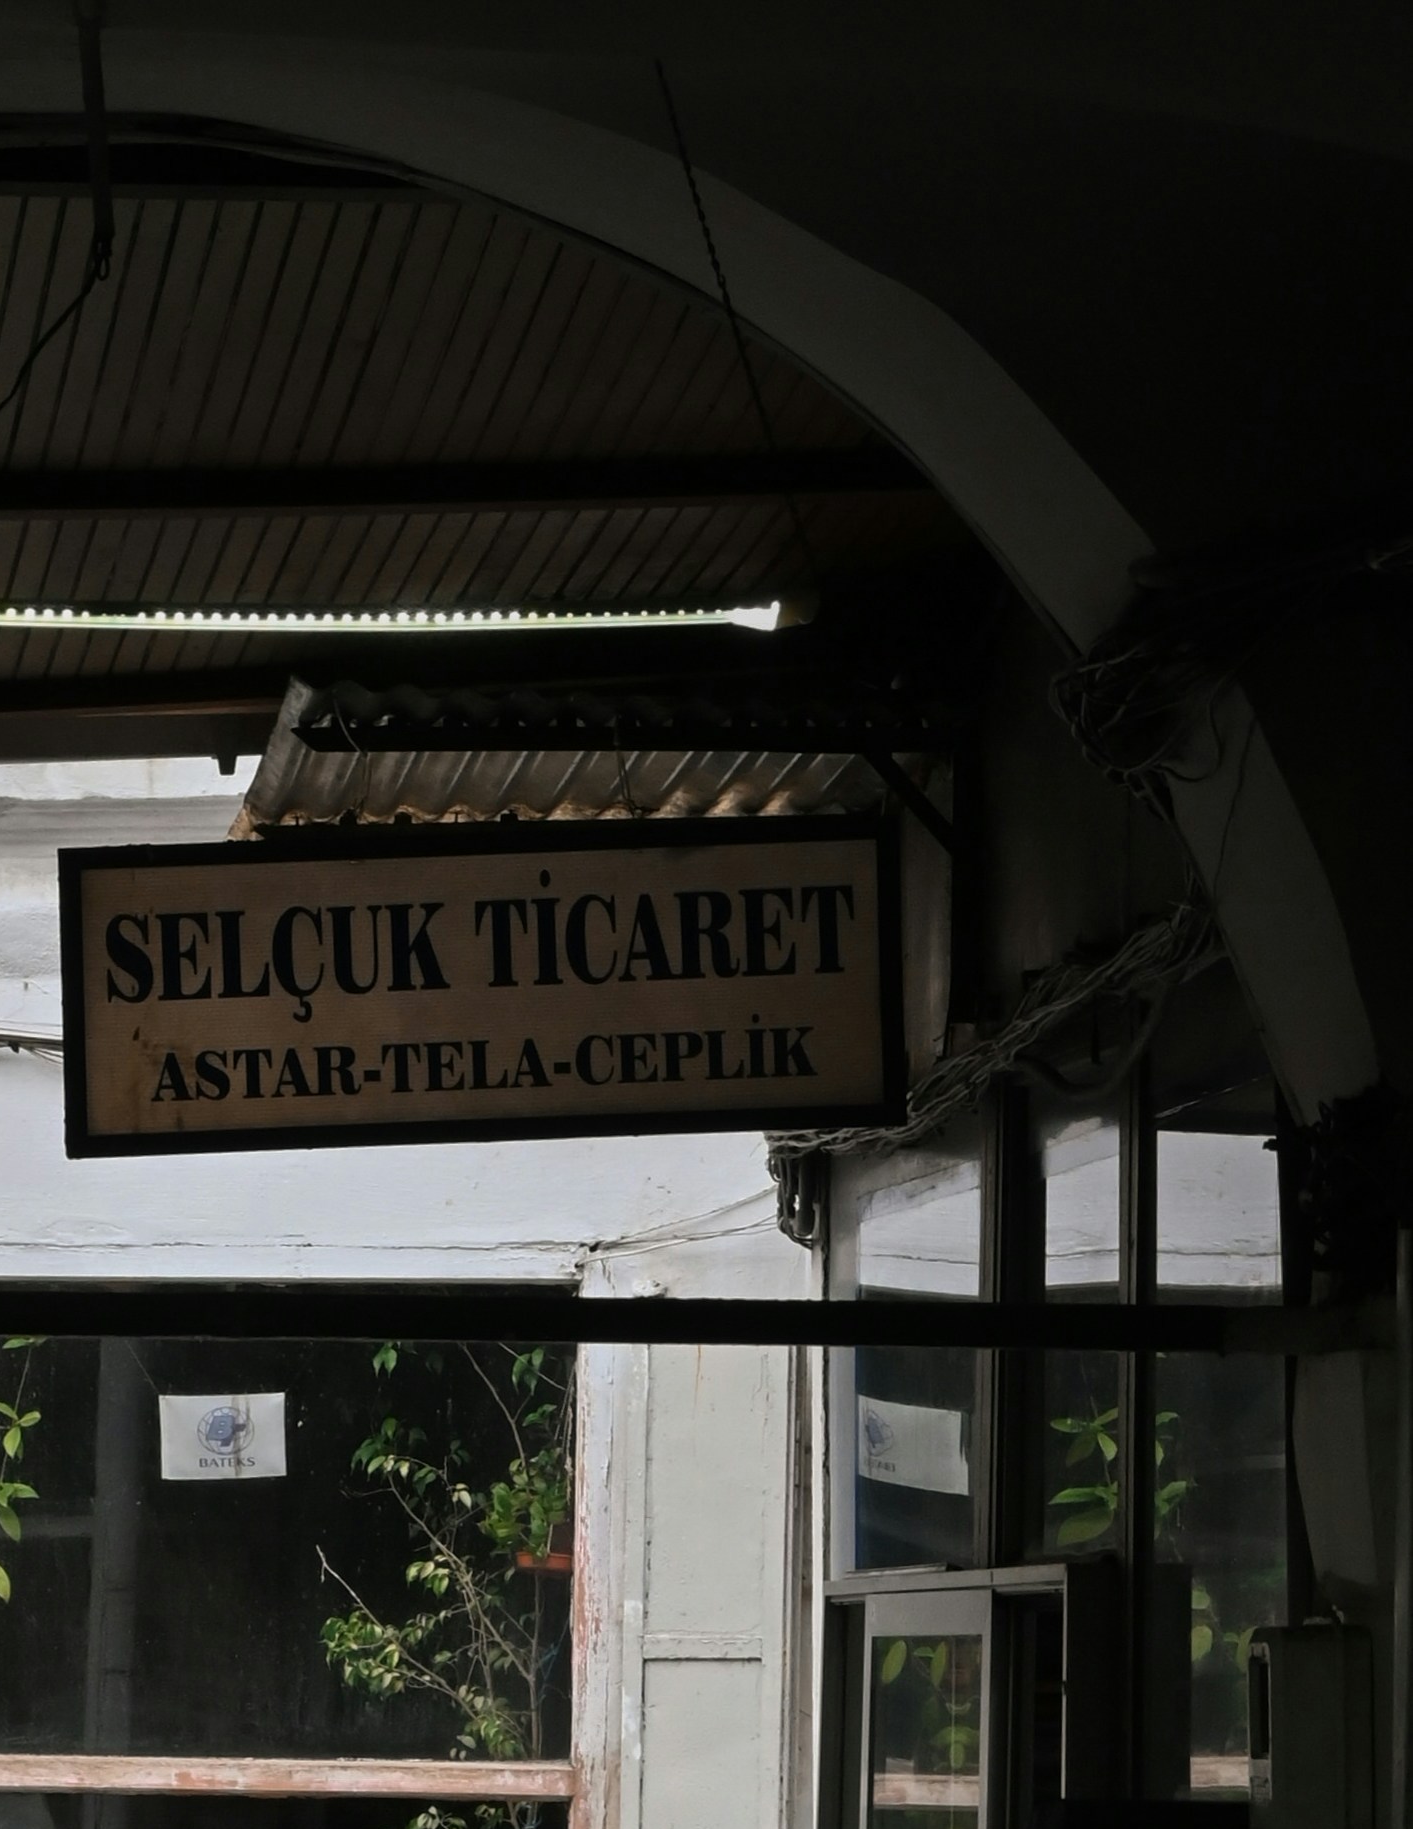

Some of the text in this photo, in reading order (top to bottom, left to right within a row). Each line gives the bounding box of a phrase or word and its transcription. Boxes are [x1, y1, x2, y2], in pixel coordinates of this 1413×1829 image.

[106, 869, 855, 1022] SELÇUK TİCARET
[151, 1014, 818, 1101] ASTAR-TELA-CEPLİK
